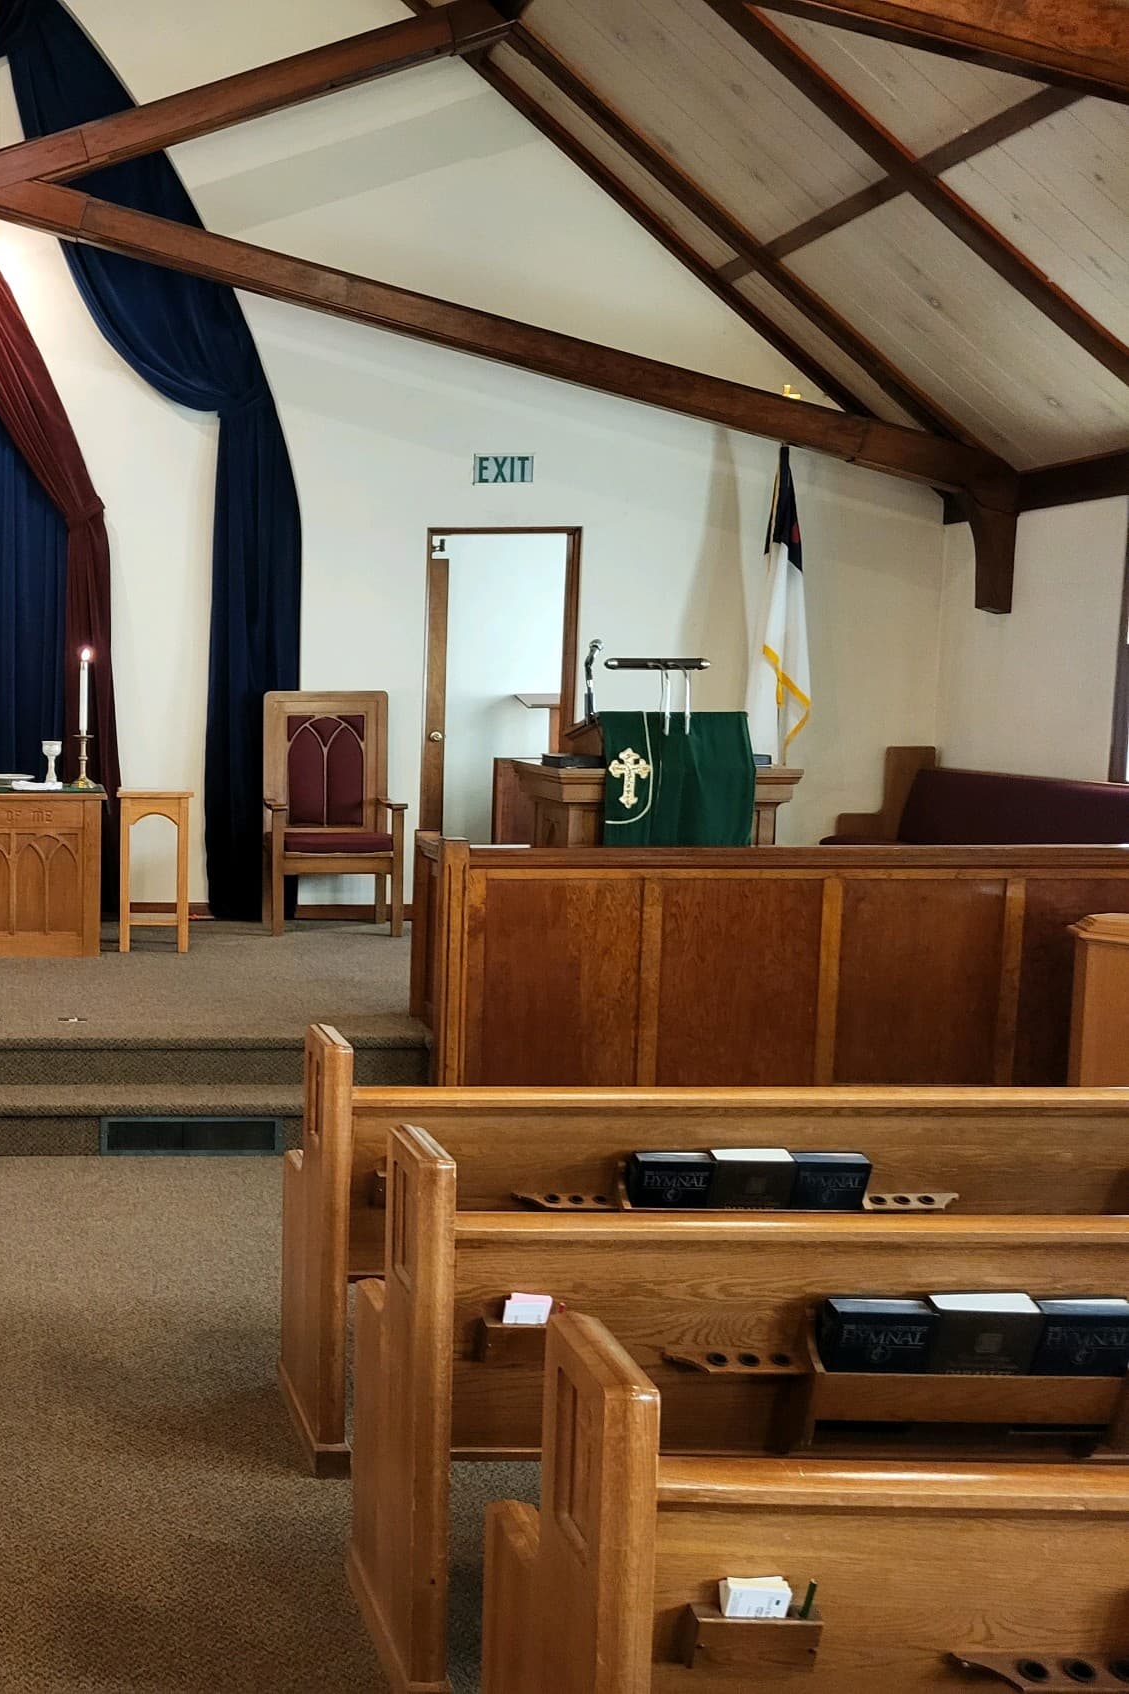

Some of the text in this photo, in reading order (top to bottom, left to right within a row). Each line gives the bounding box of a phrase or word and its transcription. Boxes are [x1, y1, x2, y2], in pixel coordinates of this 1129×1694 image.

[478, 456, 530, 483] EXIT
[5, 809, 22, 823] OF
[30, 807, 54, 823] ME
[642, 1174, 708, 1188] HYMNAL
[839, 1328, 926, 1345] HYMNAL
